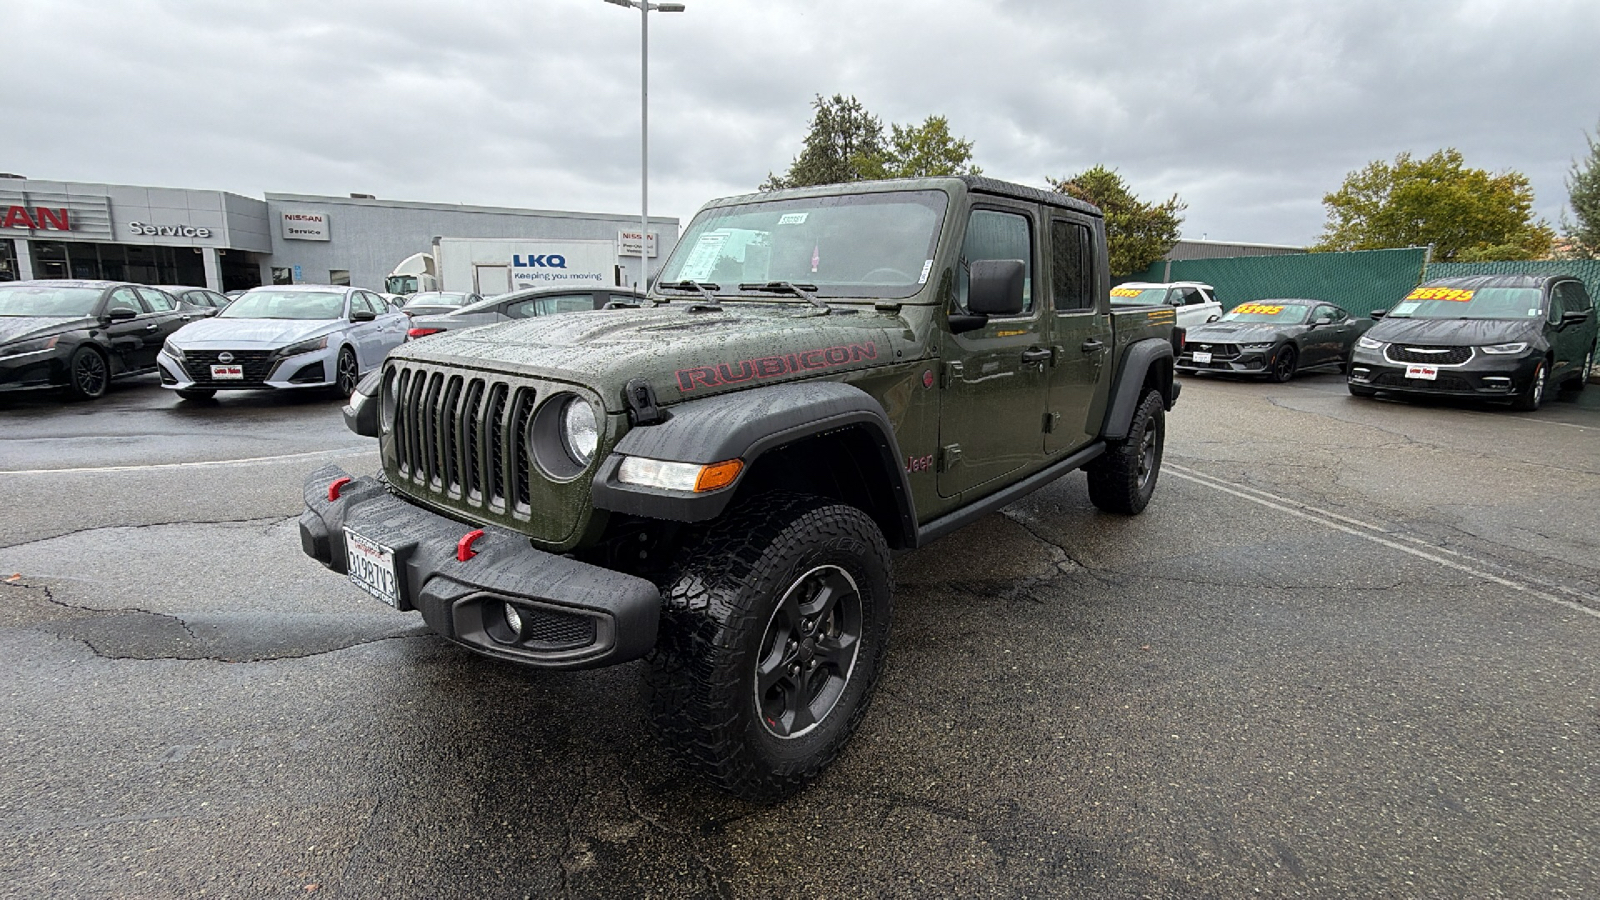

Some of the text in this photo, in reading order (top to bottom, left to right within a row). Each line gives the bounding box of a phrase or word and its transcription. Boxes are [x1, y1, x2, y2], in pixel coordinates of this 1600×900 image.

[0, 205, 70, 231] AN
[284, 214, 322, 222] NISSAN
[128, 221, 211, 238] Service
[288, 227, 321, 235] Service
[622, 232, 653, 240] NISSN
[513, 254, 567, 269] LKQ
[514, 271, 602, 281] Keeping you moving
[1406, 287, 1475, 301] 28995
[675, 341, 877, 392] RUBICON
[905, 454, 933, 473] Jeep
